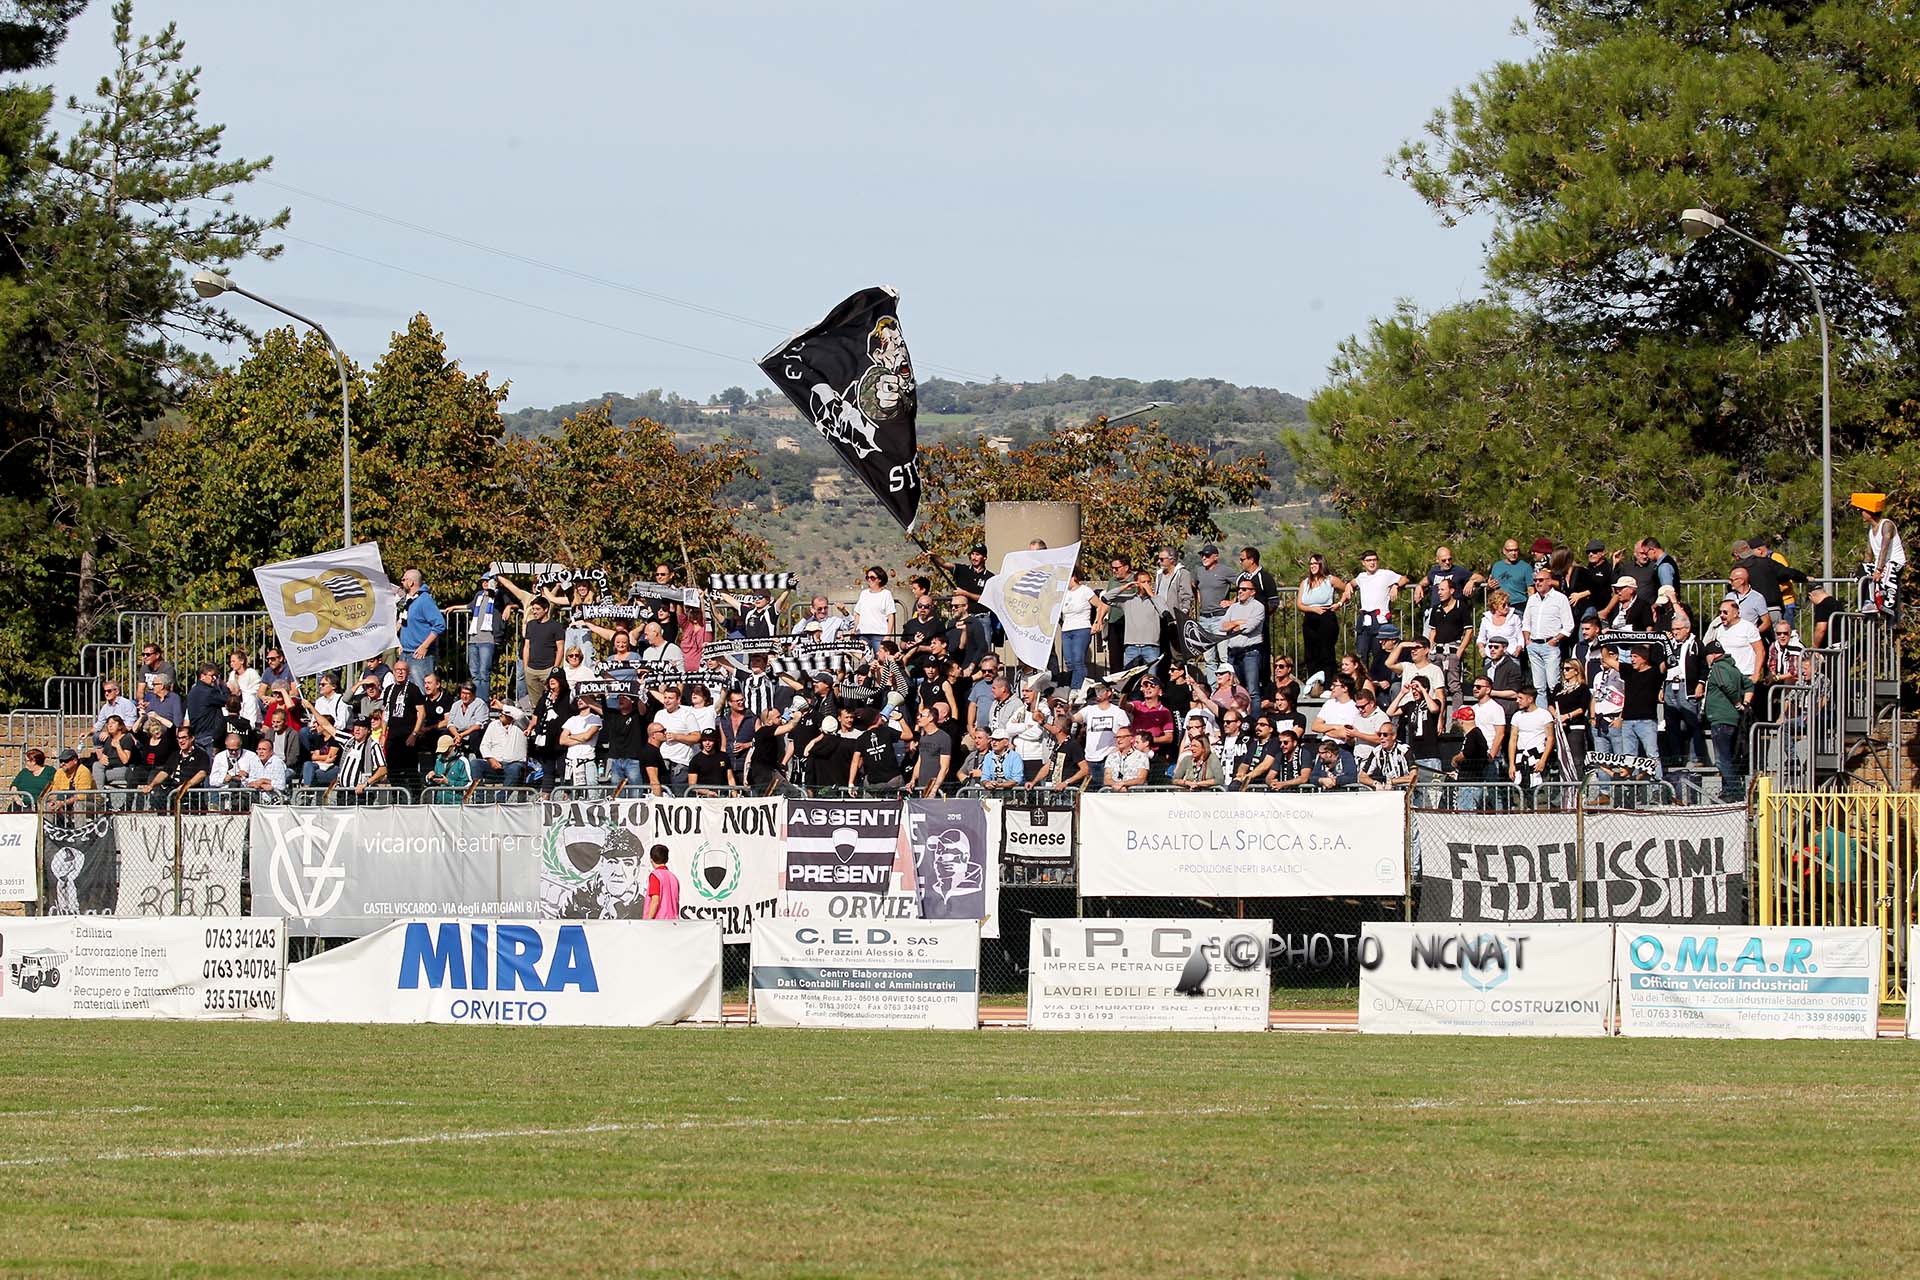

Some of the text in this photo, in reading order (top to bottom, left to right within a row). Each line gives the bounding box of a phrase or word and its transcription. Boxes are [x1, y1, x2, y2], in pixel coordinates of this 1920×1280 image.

[296, 644, 318, 654] Siena
[319, 636, 338, 647] Club
[1590, 751, 1626, 764] ROBUR
[543, 802, 649, 827] PAOLO
[655, 803, 777, 837] NOI NON
[1168, 811, 1313, 819] EVENTO IN COLLABORAZIONE CON
[363, 832, 446, 853] vicaroni
[452, 832, 523, 854] leather
[1010, 832, 1066, 845] senese
[788, 865, 892, 884] PRESENT
[1179, 864, 1302, 873] PRODUZIONE INERTI BASALTICI
[364, 902, 394, 914] CASTEL
[395, 902, 437, 914] VISCARDO
[442, 902, 456, 914] VIA
[457, 902, 480, 917] degli
[481, 901, 525, 914] ARTIGIANI
[76, 927, 112, 939] Edilizia
[205, 928, 276, 949] 0763 341243
[795, 928, 939, 946] C.E.D. SAS
[76, 945, 167, 958] Lavorazione Inerti
[398, 922, 600, 993] MIRA
[805, 948, 928, 957] di Perazzini Alessio & C.
[1629, 935, 1818, 974] O.M.A.R.
[75, 965, 159, 977] Movimento Terra
[203, 959, 277, 980] 0763 340784
[1044, 962, 1105, 971] IMPRESA
[820, 969, 913, 979] Centro Elaborazione
[777, 978, 956, 990] Dati Contabili Fiscali ed Amministrativi
[1639, 976, 1808, 991] Officina Veicoli Industriali
[74, 985, 121, 998] Recupero
[133, 984, 196, 997] Trattamento
[773, 992, 798, 1000] Piazza
[801, 993, 821, 1001] Monte
[881, 995, 915, 1003] ORVIETO
[1044, 987, 1260, 998] LAVORI EDILI E FEOVIARI
[74, 999, 150, 1010] materiali inerti
[204, 989, 224, 1009] 335
[1631, 993, 1644, 1002] Via
[1648, 994, 1659, 1003] dei
[1736, 995, 1784, 1006] Industriale
[1785, 996, 1824, 1006] Bardano
[1831, 997, 1868, 1007] ORVIETO
[451, 999, 548, 1021] ORVIETO
[868, 1003, 881, 1011] Fax
[1372, 998, 1599, 1014] GUAZZAROTTO COSTRUZIONI
[1042, 1012, 1071, 1020] 0763
[1075, 1012, 1113, 1020] 316193
[1647, 1009, 1672, 1018] 0763
[1738, 1010, 1781, 1022] Telefono
[1806, 1012, 1825, 1022] 339
[1827, 1012, 1867, 1022] 8490905
